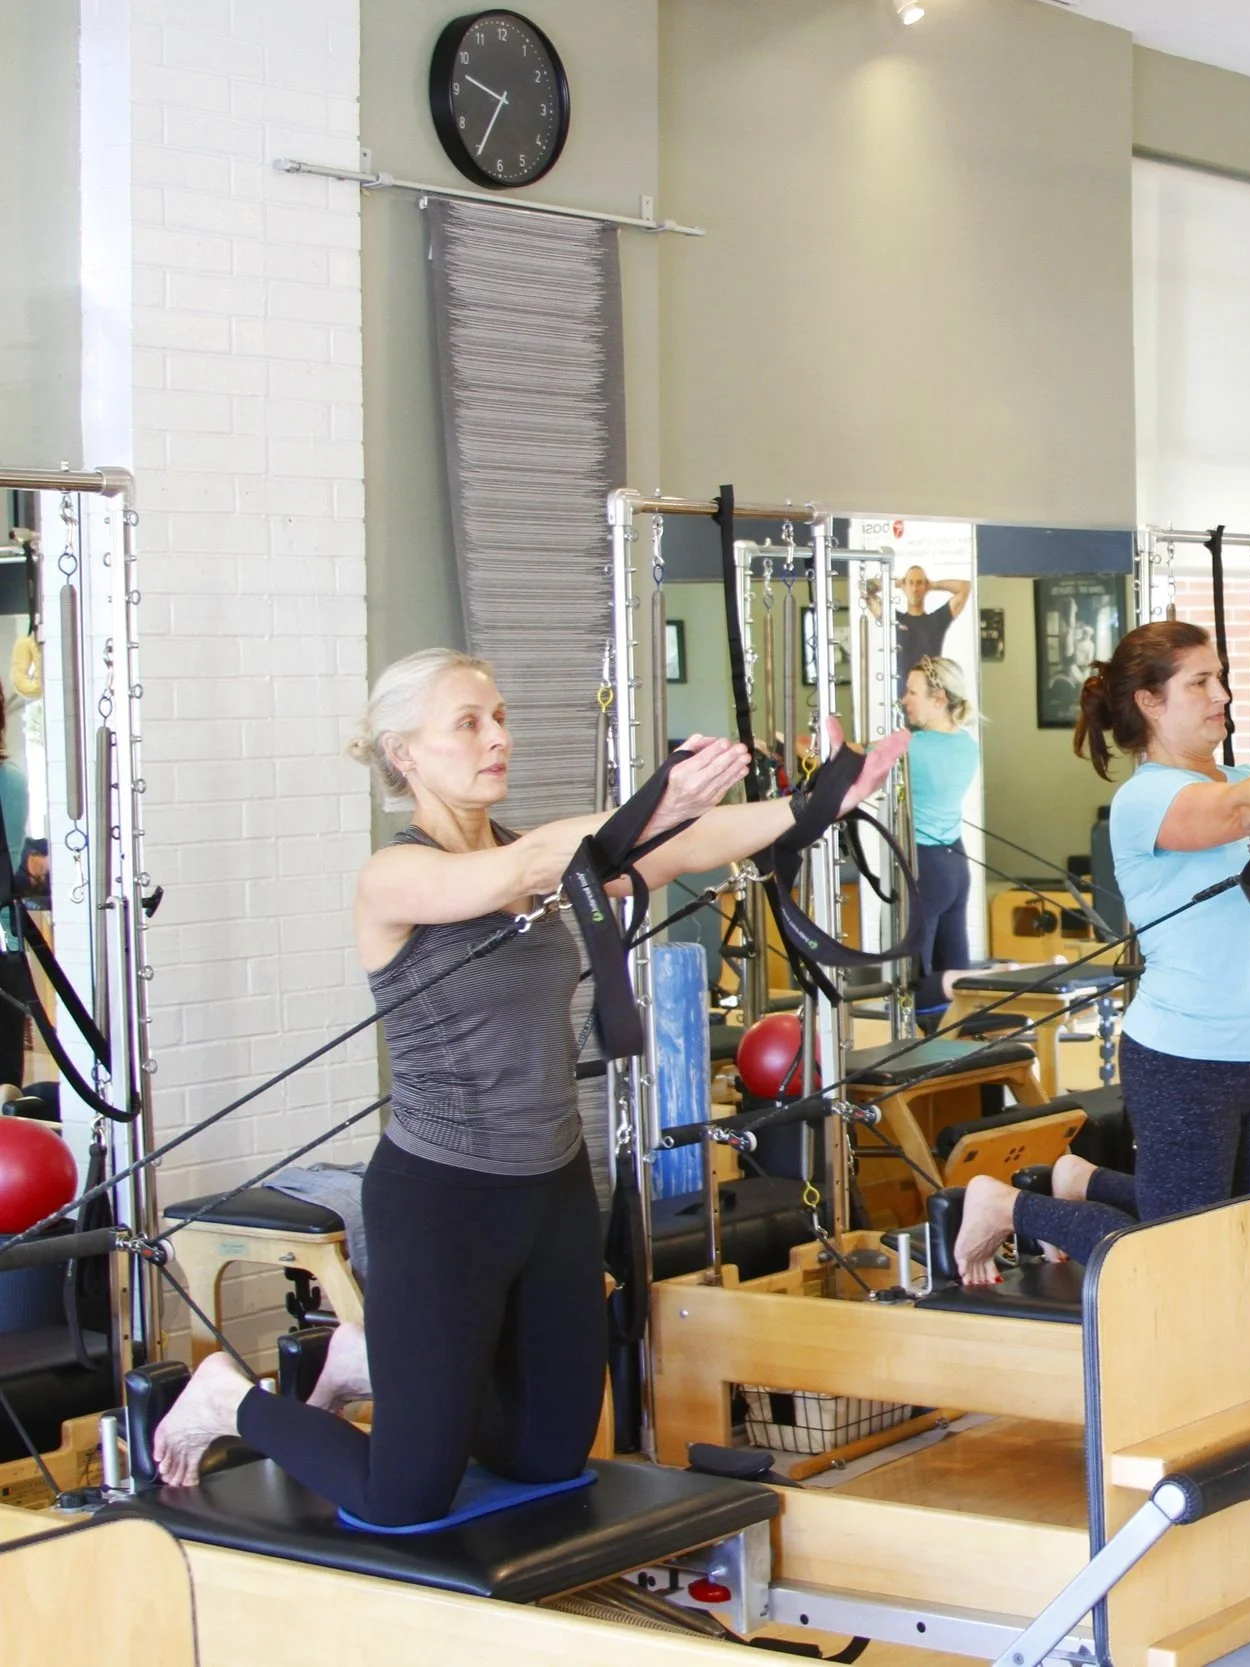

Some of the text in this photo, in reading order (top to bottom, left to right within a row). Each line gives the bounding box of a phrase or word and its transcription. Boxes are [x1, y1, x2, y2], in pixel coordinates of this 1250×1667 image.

[476, 33, 485, 46] 11
[498, 28, 507, 42] 12
[522, 45, 527, 56] 1
[459, 52, 469, 65] 10
[535, 70, 541, 83] 2
[453, 83, 460, 95] 9
[540, 104, 547, 116] 3
[459, 116, 466, 129] 8
[535, 134, 542, 146] 4
[497, 159, 504, 172] 6
[519, 154, 526, 167] 5
